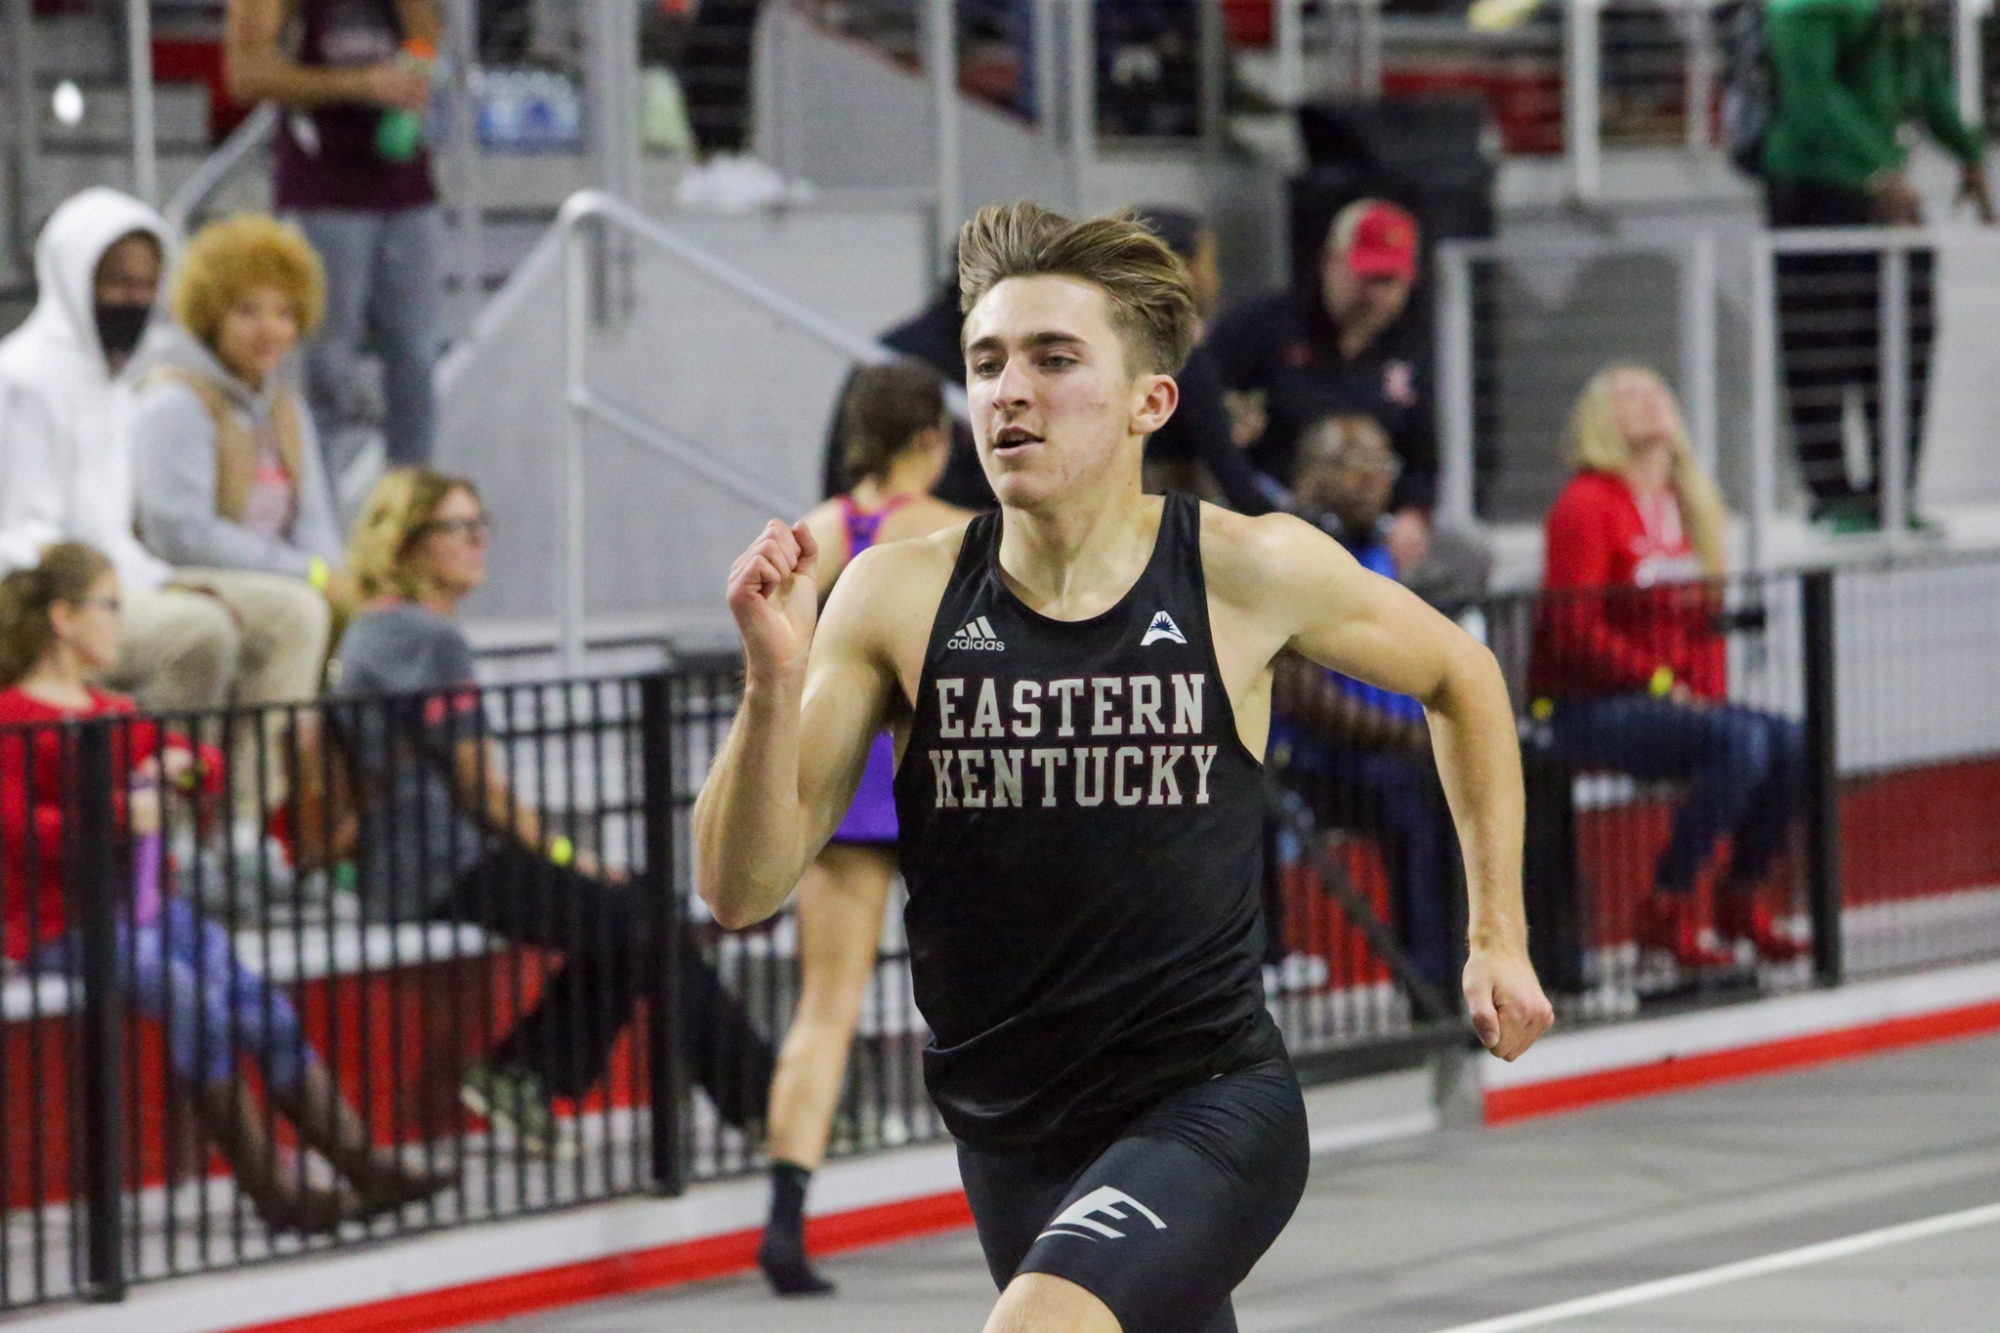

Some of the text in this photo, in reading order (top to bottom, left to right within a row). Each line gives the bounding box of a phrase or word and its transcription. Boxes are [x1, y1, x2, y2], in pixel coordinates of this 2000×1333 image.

[947, 636, 1005, 651] adidas
[936, 673, 1205, 738] EASTERN
[928, 745, 1218, 808] KENTUCKY
